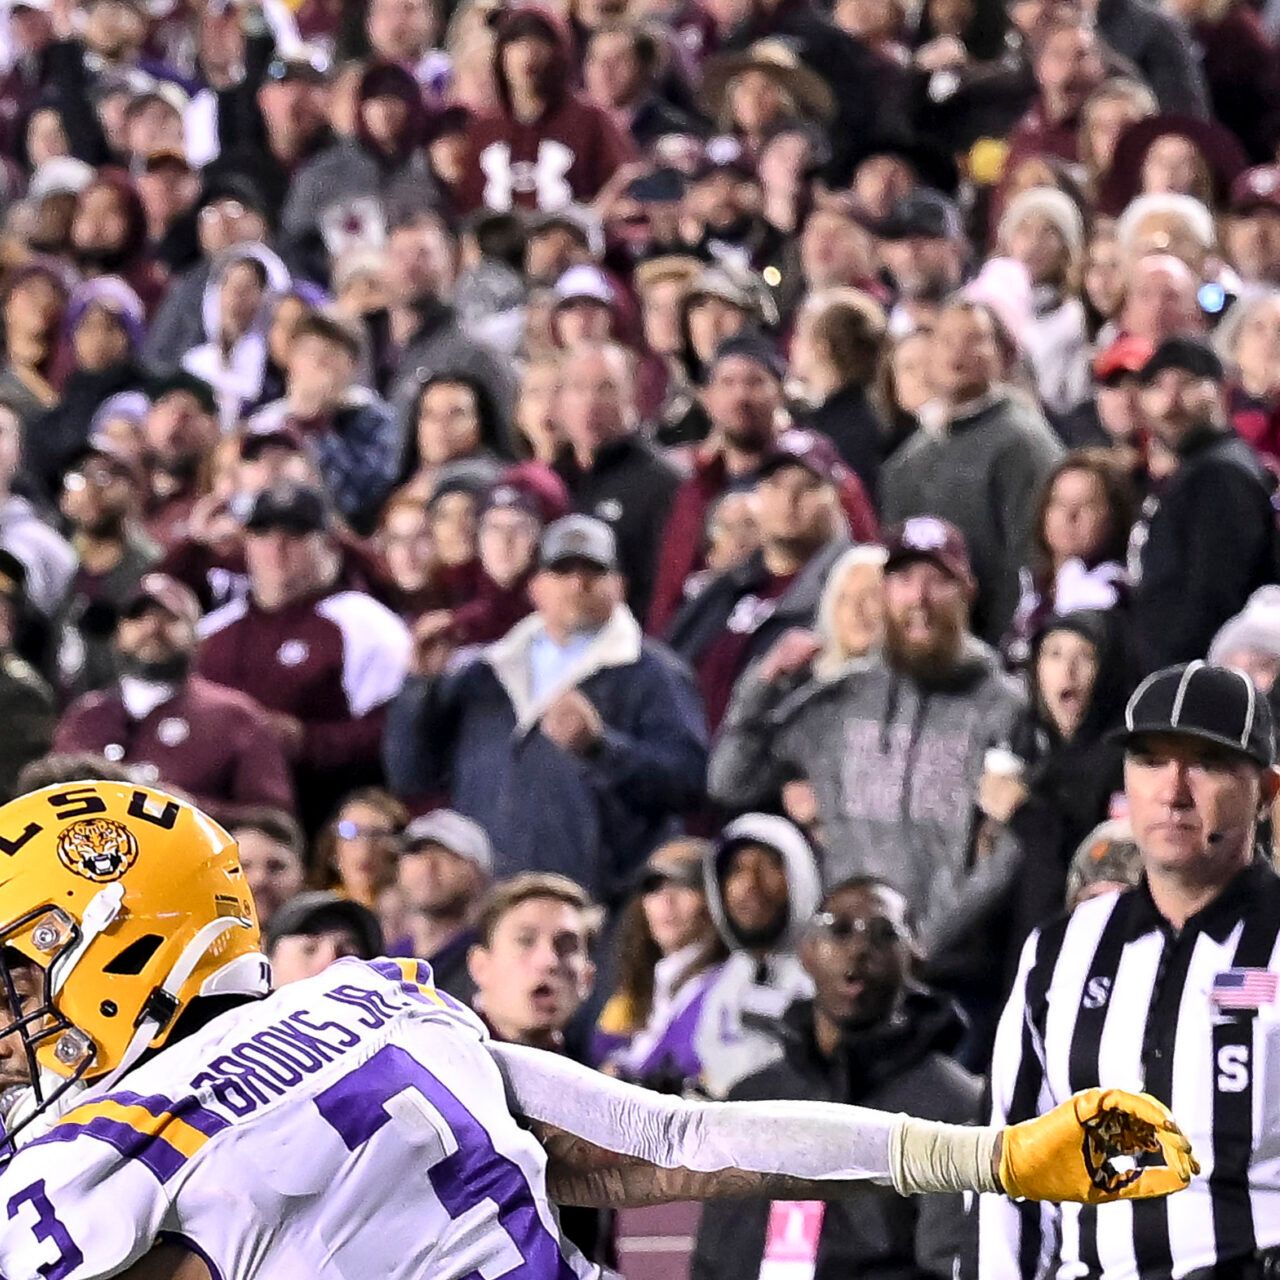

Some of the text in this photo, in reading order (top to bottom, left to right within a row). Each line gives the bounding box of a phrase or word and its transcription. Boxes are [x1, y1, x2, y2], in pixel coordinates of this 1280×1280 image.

[1082, 975, 1112, 1009] S
[189, 1009, 361, 1118] BROOKS
[1217, 1044, 1250, 1093] S
